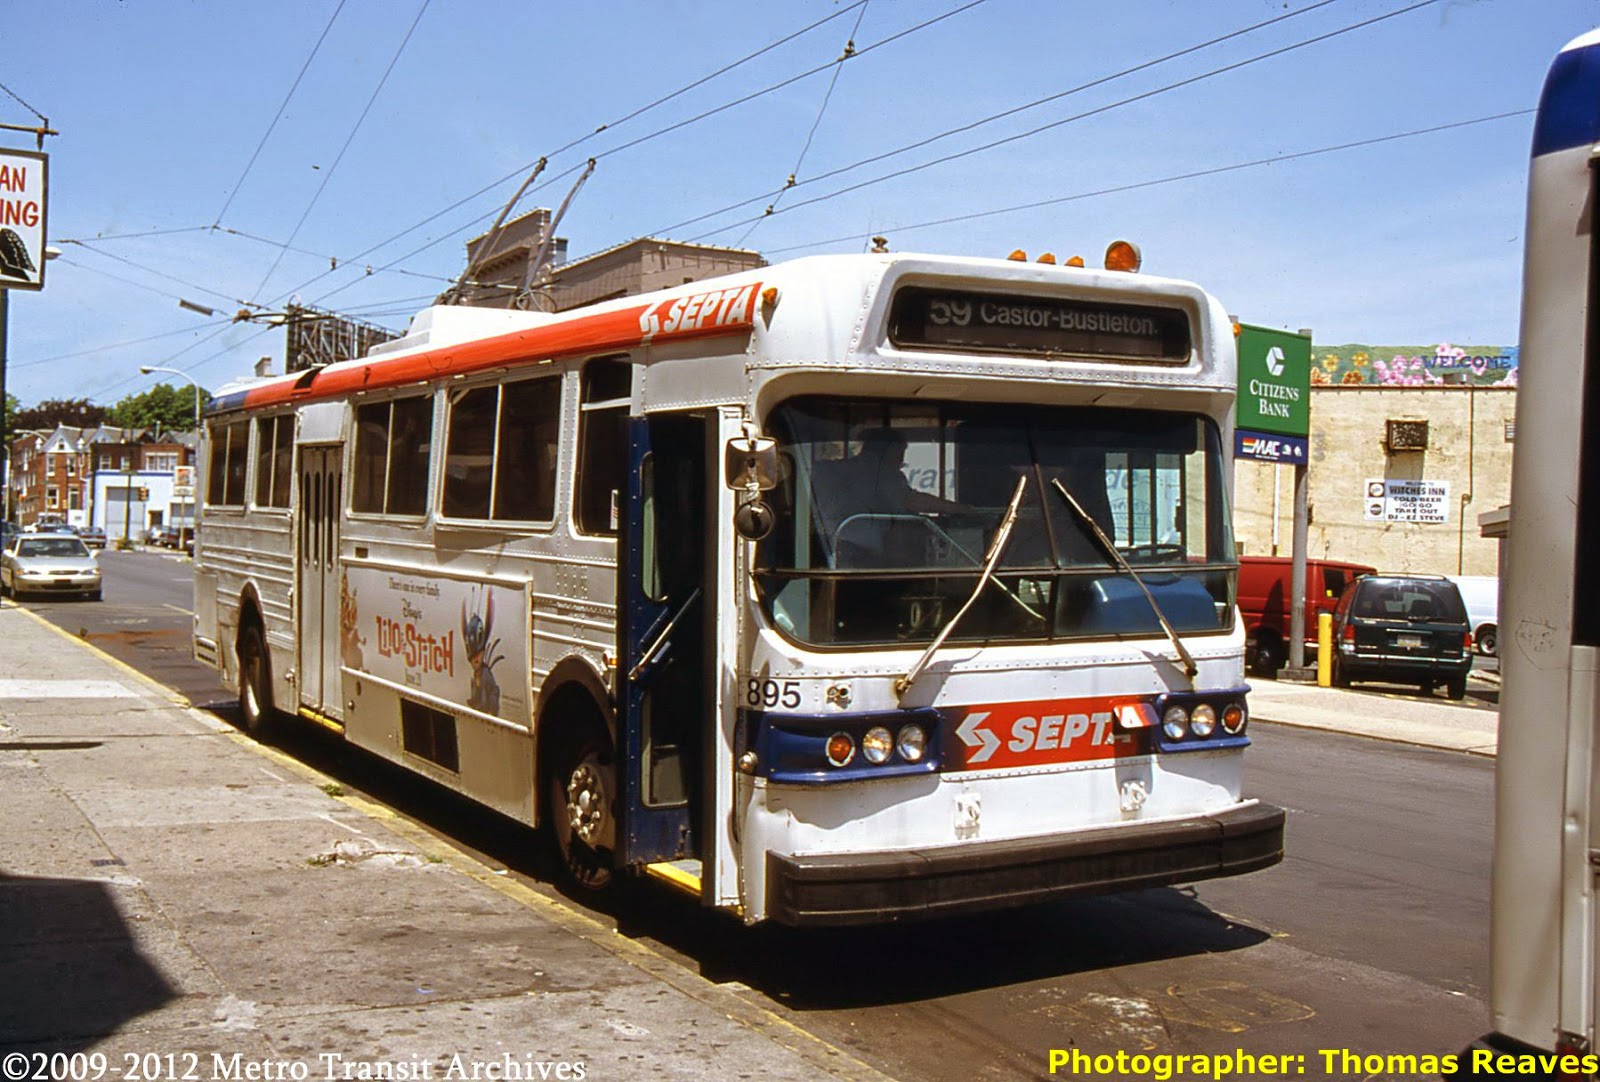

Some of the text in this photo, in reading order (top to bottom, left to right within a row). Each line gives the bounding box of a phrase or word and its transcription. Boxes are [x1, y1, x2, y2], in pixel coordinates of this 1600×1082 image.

[663, 285, 755, 333] SEPTA
[930, 299, 972, 326] 59
[1421, 355, 1511, 369] WELCOME
[1249, 379, 1299, 401] CITIZENS
[1259, 398, 1290, 418] BANK
[1255, 439, 1281, 456] MAC
[1389, 486, 1426, 496] WITCHES
[1428, 487, 1446, 496] INN
[747, 679, 802, 709] 895
